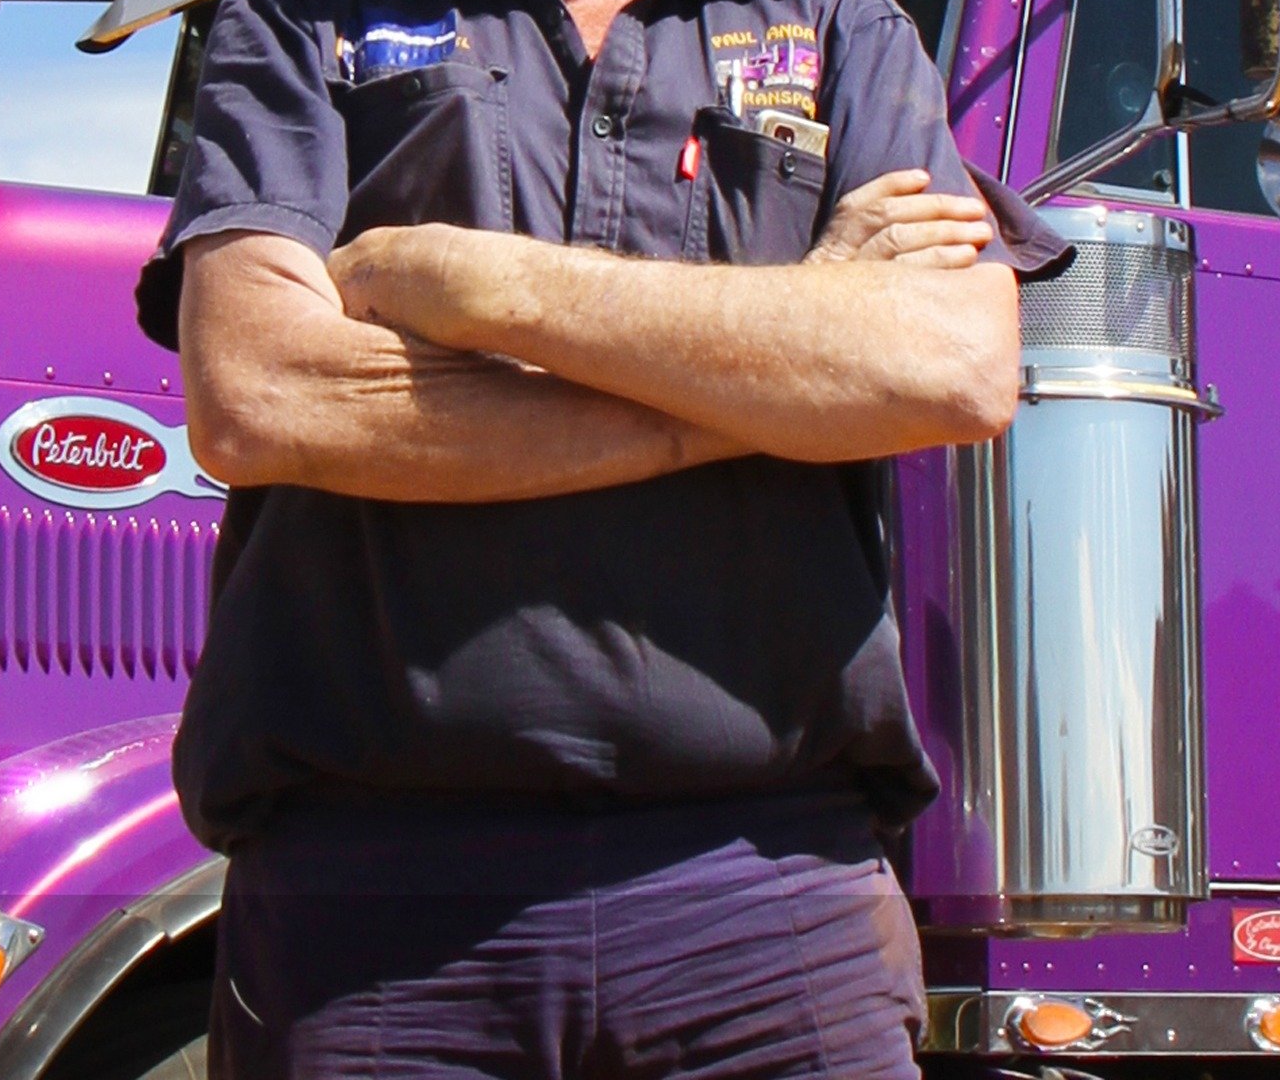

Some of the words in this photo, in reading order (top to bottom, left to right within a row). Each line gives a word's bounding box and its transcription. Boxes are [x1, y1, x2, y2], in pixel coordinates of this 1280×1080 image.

[710, 31, 757, 48] PAUL
[742, 90, 817, 121] RANSPO
[32, 423, 155, 470] Peterbilt
